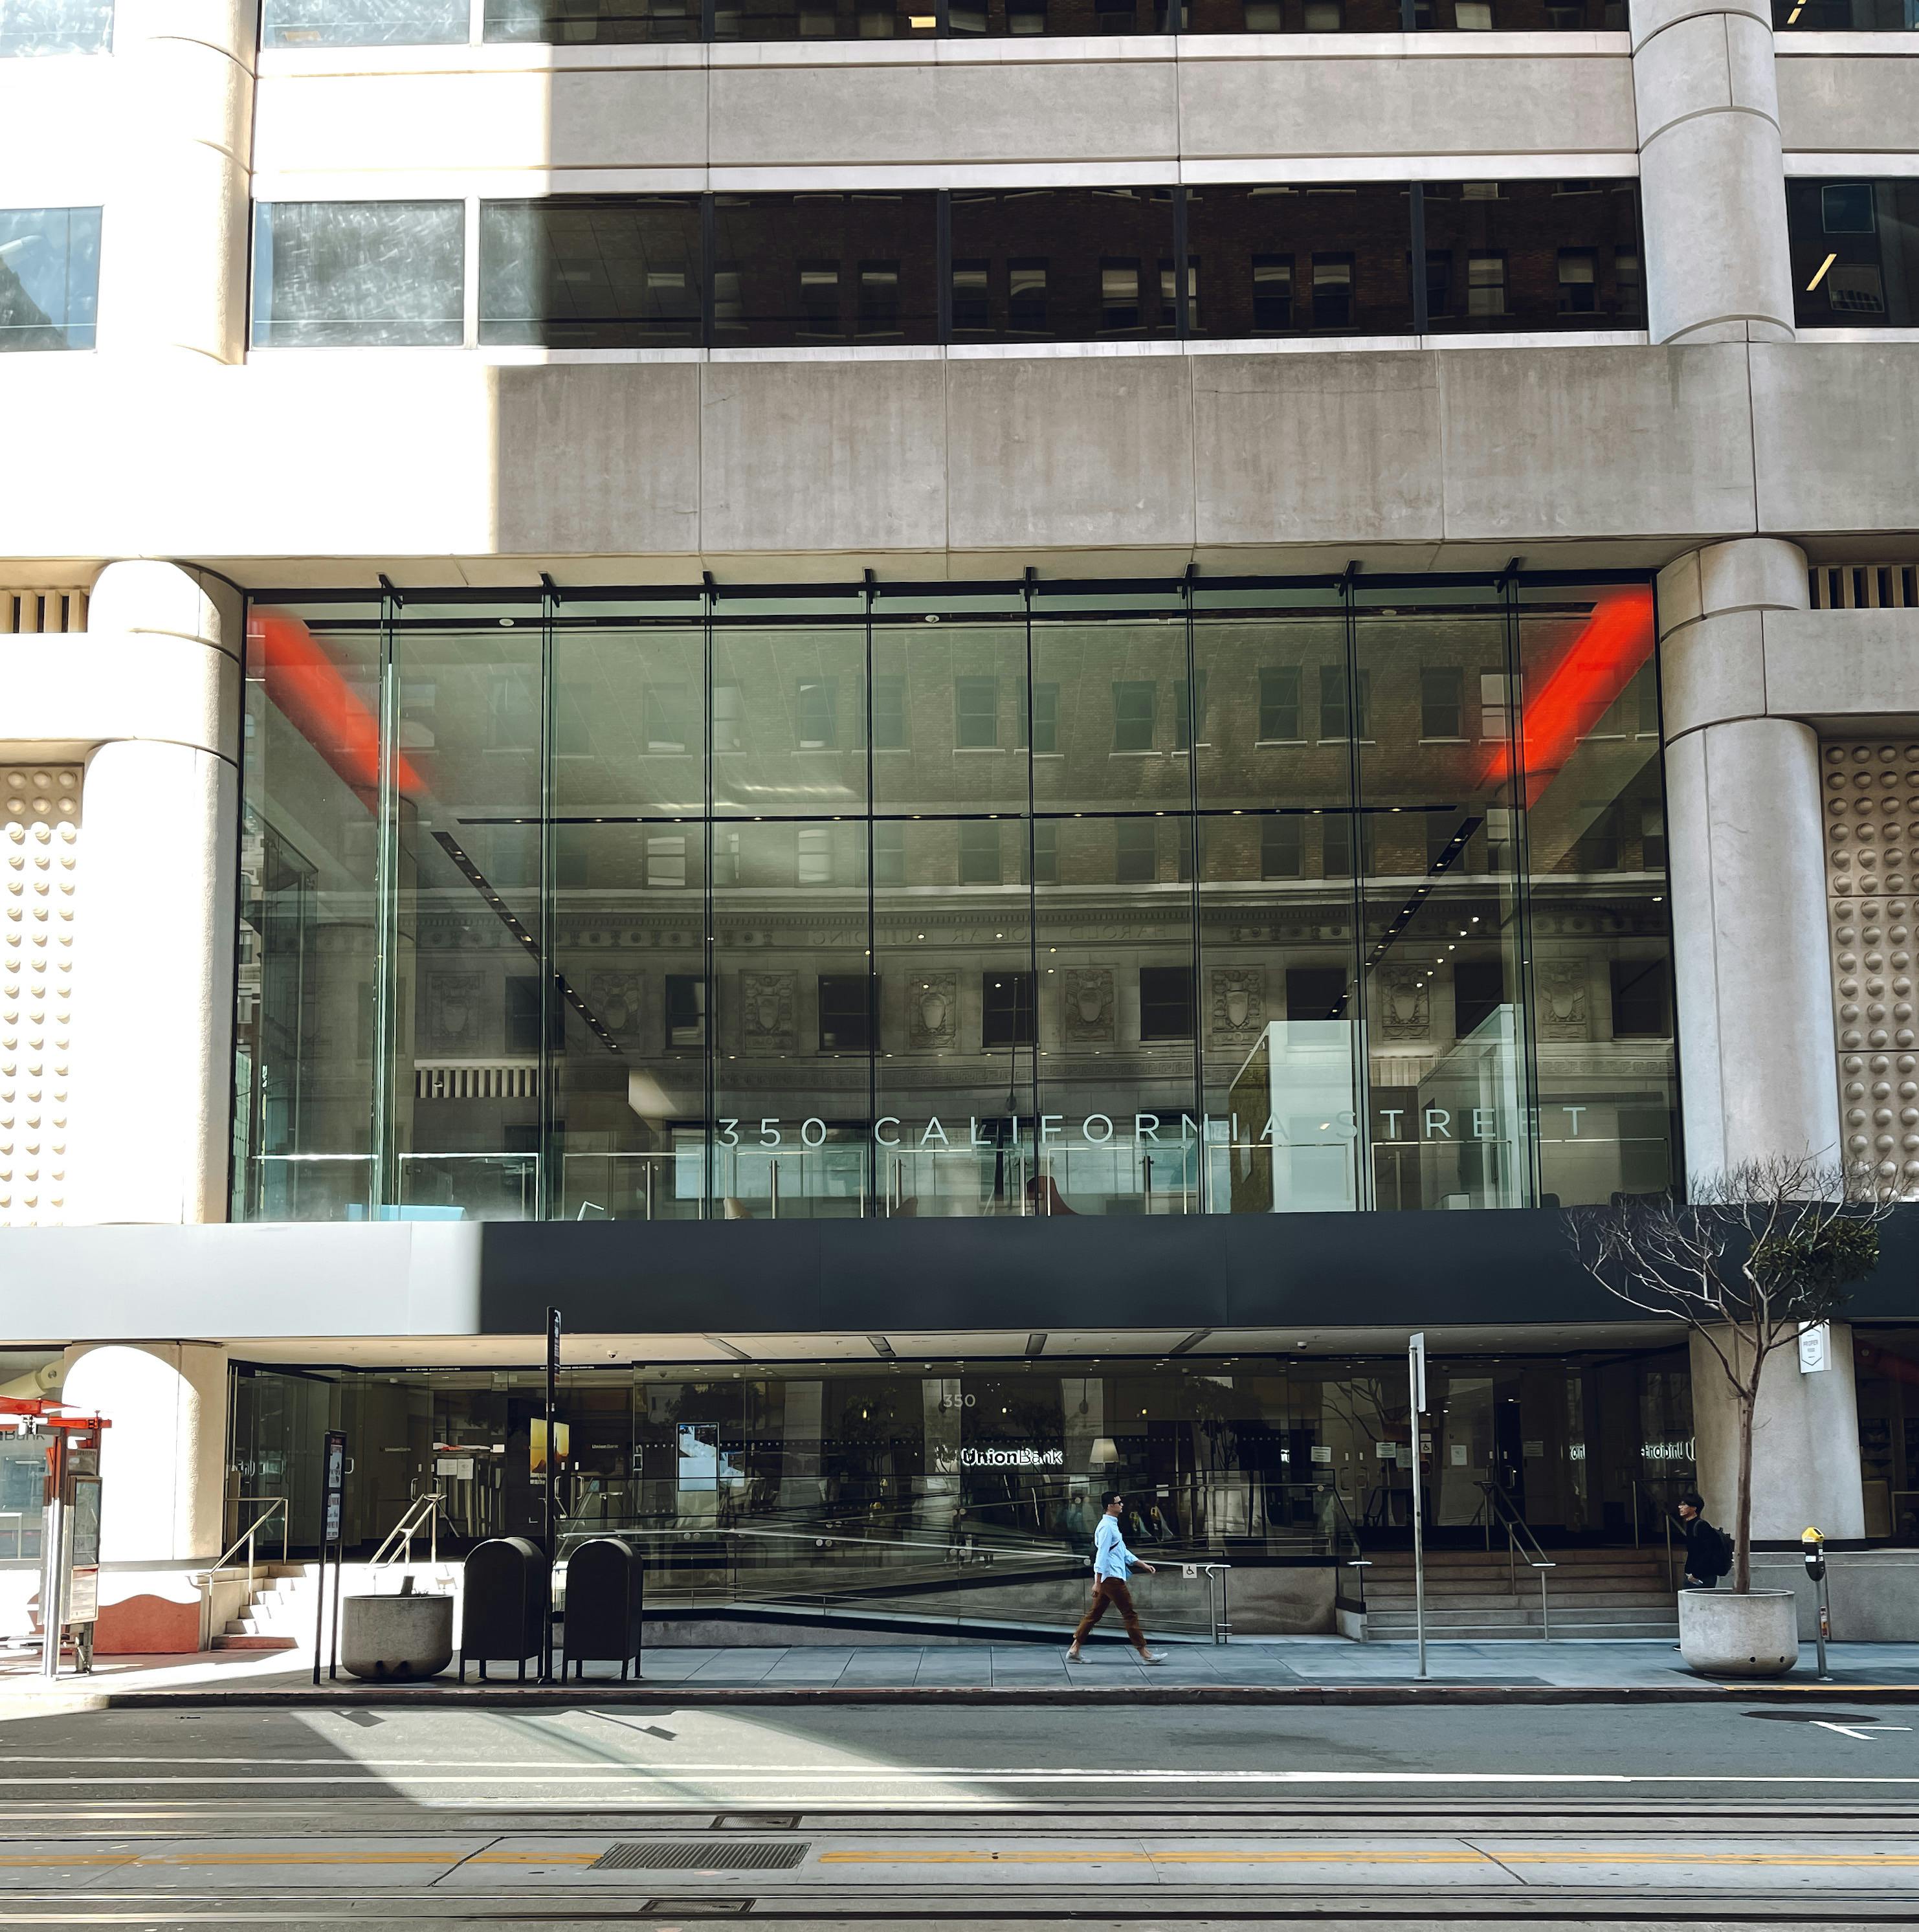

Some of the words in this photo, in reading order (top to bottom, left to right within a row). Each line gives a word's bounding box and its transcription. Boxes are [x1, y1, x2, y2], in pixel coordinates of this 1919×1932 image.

[717, 1117, 827, 1147] 350
[874, 1112, 1289, 1146] CALIFORNIA
[1335, 1106, 1587, 1139] STREET
[943, 1393, 976, 1408] 350
[961, 1447, 1063, 1465] UnionBank
